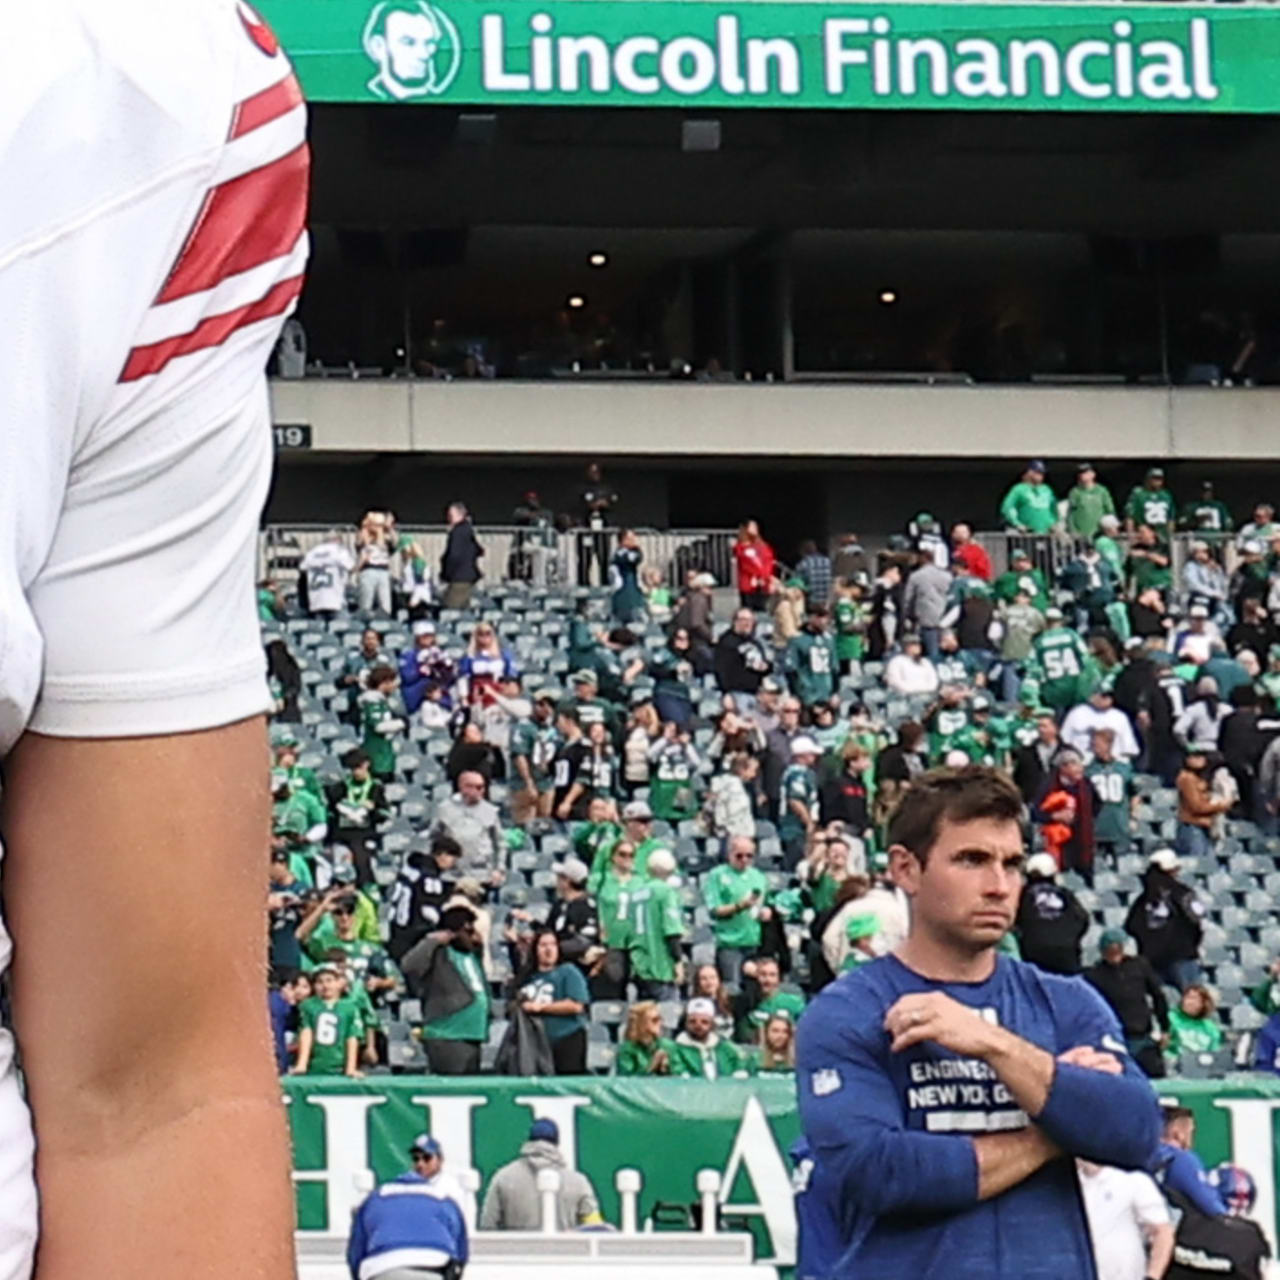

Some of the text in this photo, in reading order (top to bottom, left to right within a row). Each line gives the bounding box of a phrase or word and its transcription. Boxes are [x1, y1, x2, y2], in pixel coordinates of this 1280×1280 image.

[482, 13, 1218, 99] Lincoln Financial
[1043, 646, 1080, 680] 54
[316, 1011, 338, 1046] 6
[908, 1084, 958, 1109] NEW
